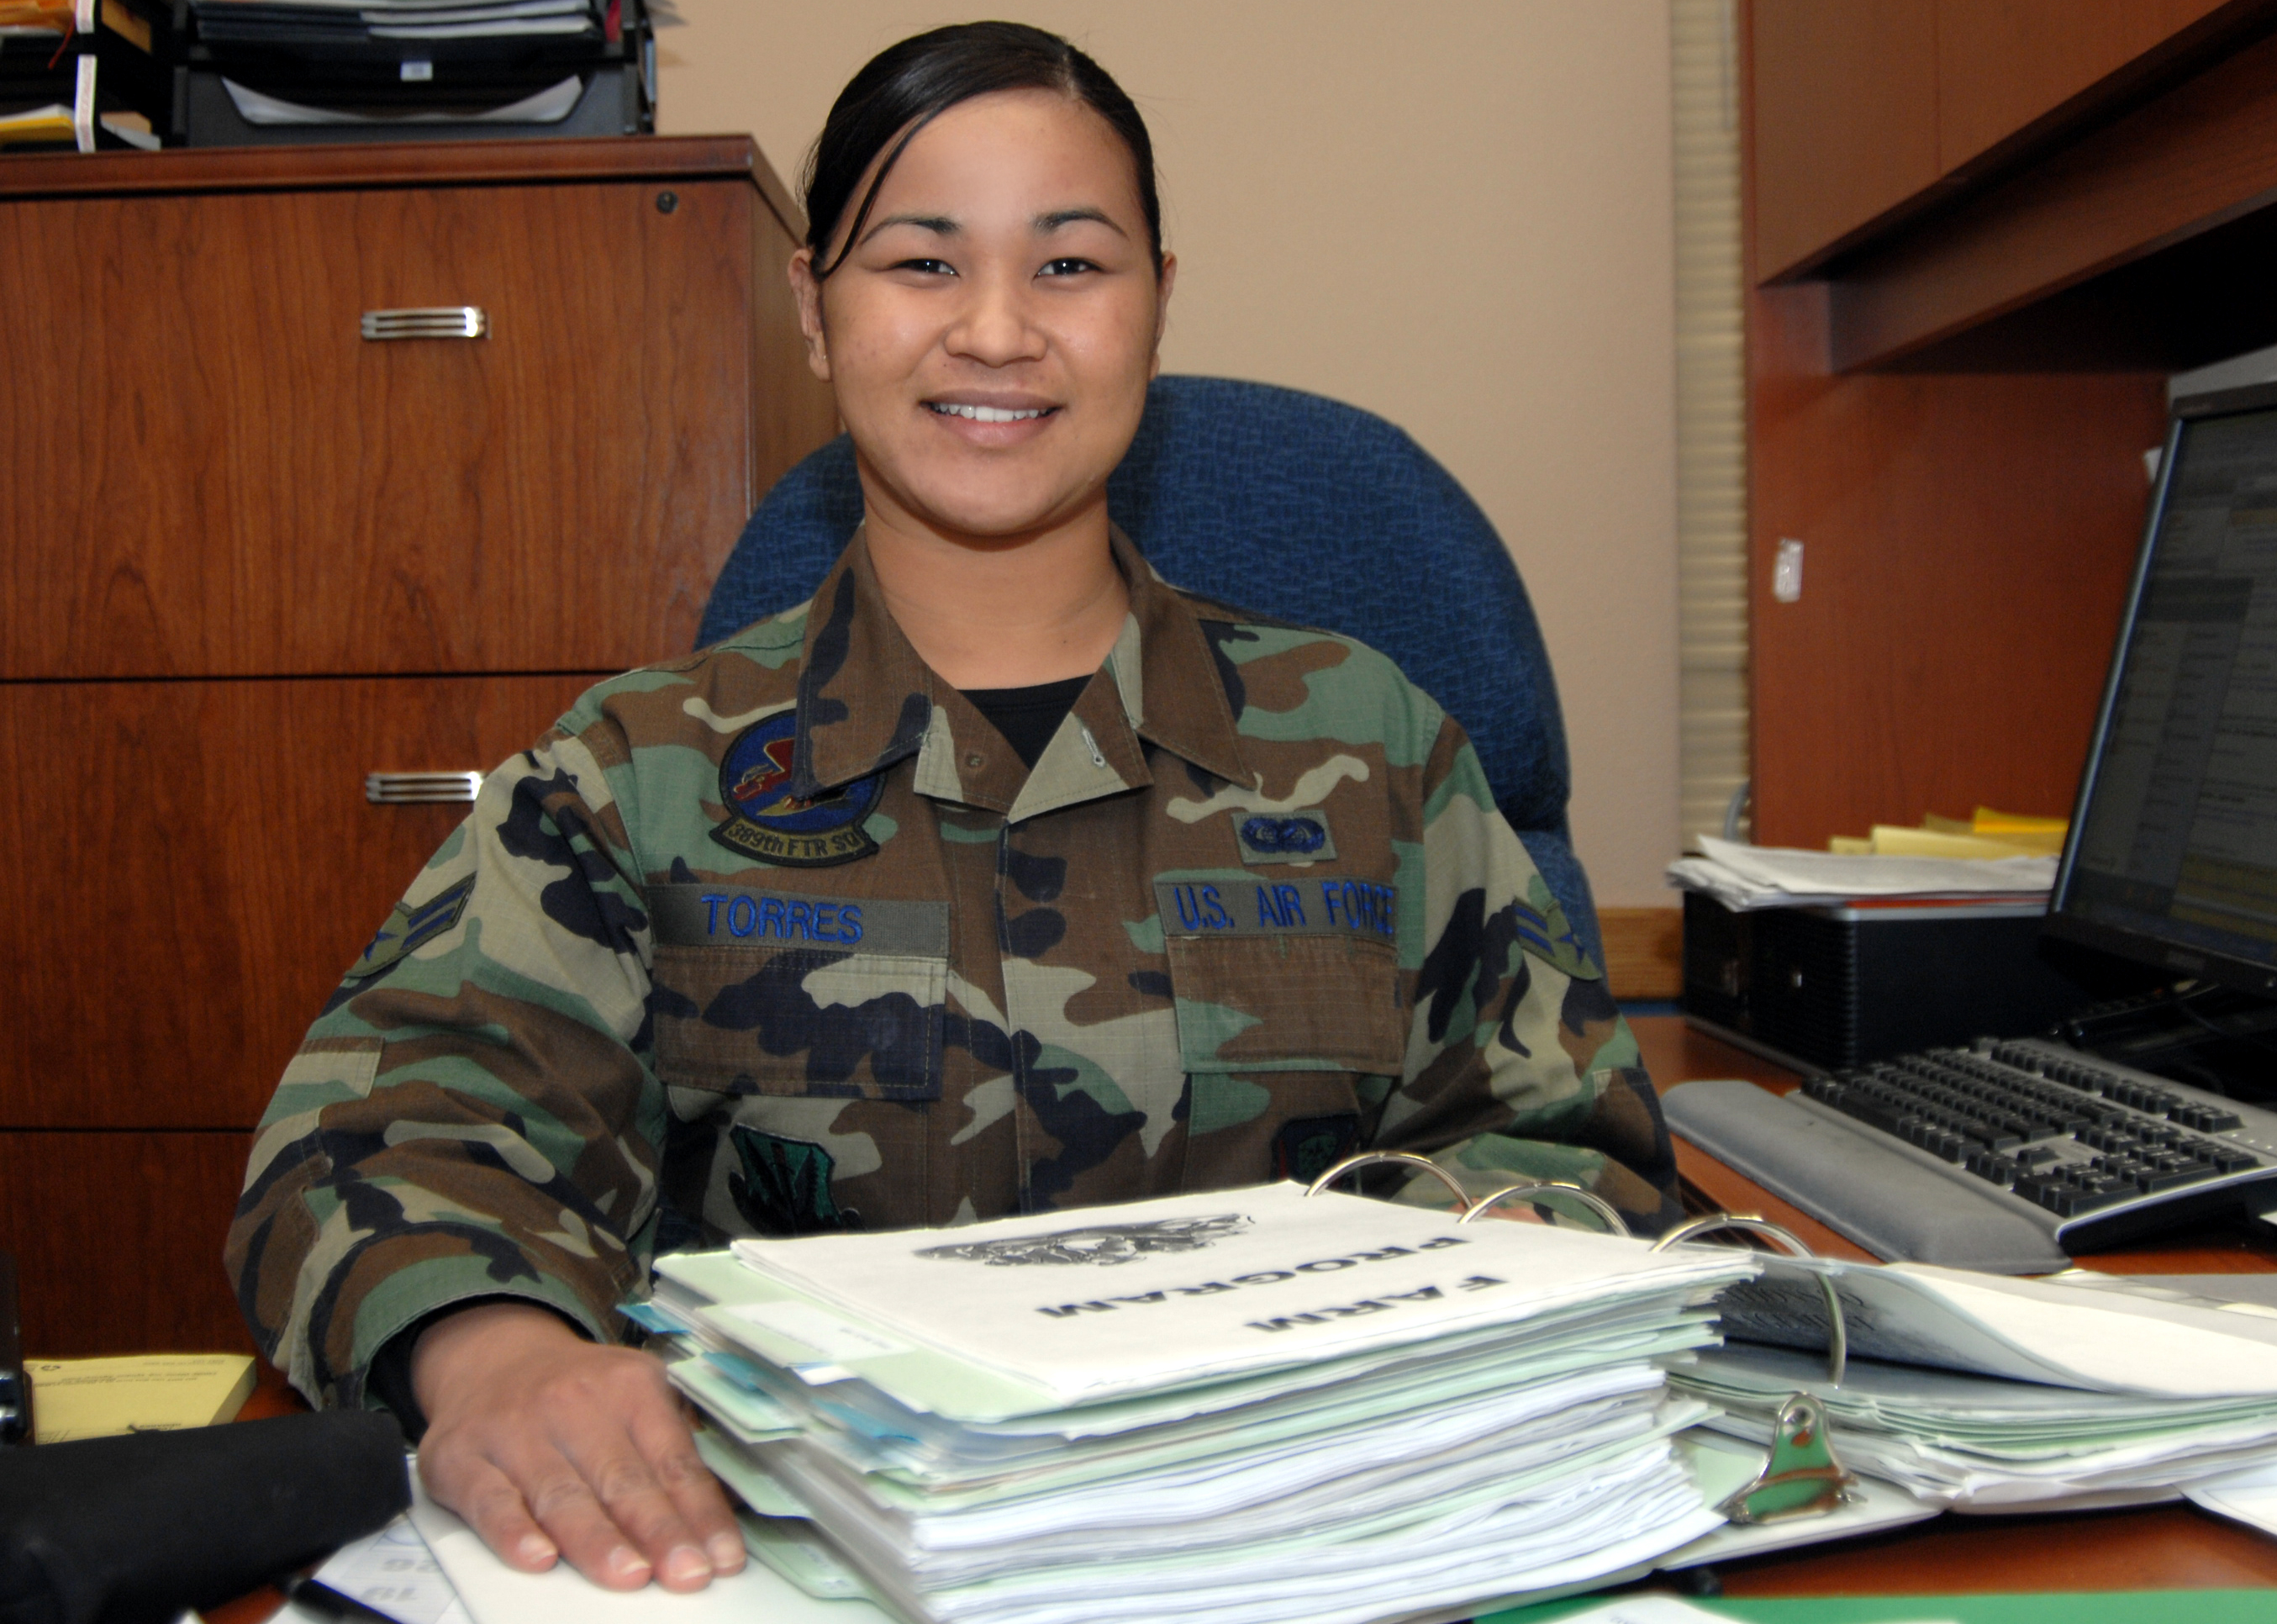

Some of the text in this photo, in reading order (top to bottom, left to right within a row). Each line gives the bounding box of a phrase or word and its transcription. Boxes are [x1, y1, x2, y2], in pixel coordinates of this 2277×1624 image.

[727, 823, 783, 855] 389th
[786, 838, 829, 857] FTR
[700, 893, 864, 946] TORRES
[1174, 881, 1394, 935] U.S. AIR FORCE
[1034, 1236, 1471, 1318] PROGRAM
[1244, 1274, 1509, 1333] FARM
